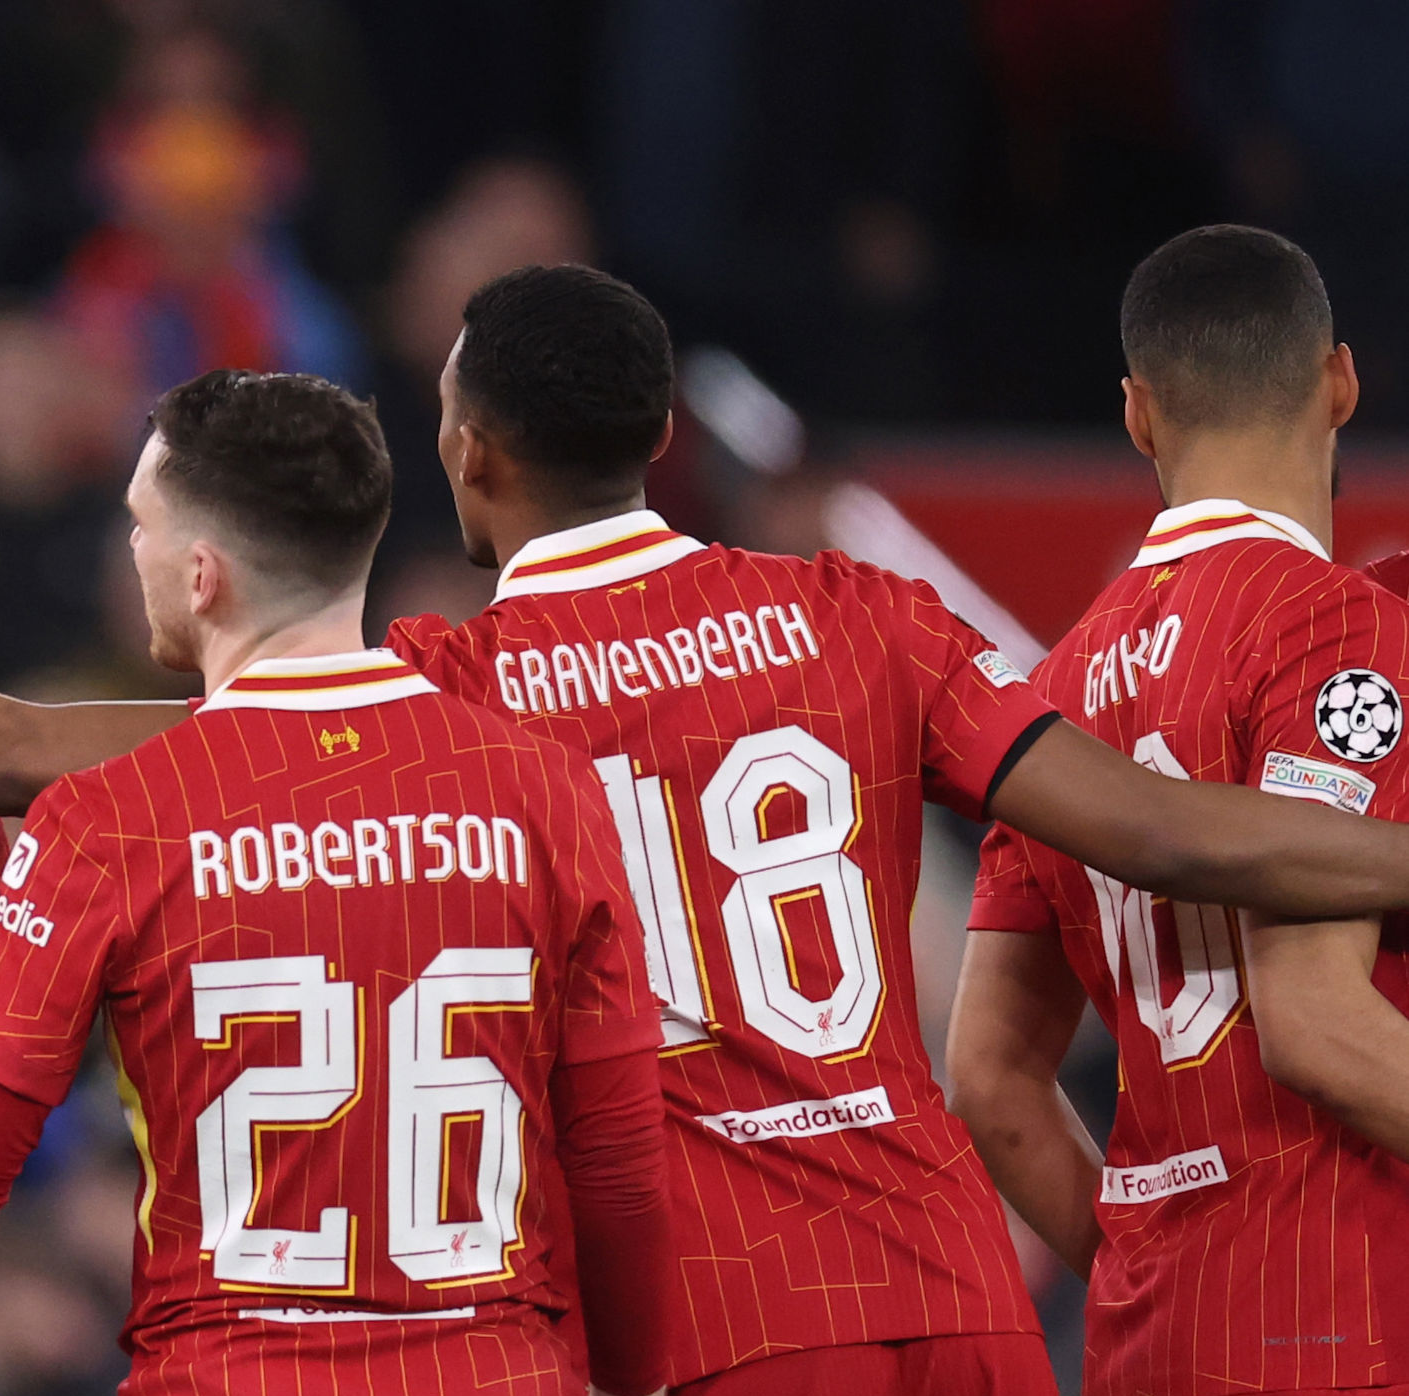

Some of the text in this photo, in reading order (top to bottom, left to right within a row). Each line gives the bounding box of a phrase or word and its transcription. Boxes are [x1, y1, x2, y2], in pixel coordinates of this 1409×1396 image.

[494, 602, 821, 715] GRAVENBERCH
[1084, 613, 1182, 719] GAKO
[1349, 697, 1373, 733] 6
[1265, 765, 1368, 805] FOUNDATION
[1268, 754, 1295, 767] UEFA
[190, 812, 528, 899] ROBERTSON
[593, 724, 887, 1064] 18
[190, 946, 540, 1296] 26
[721, 1100, 884, 1138] Foundation
